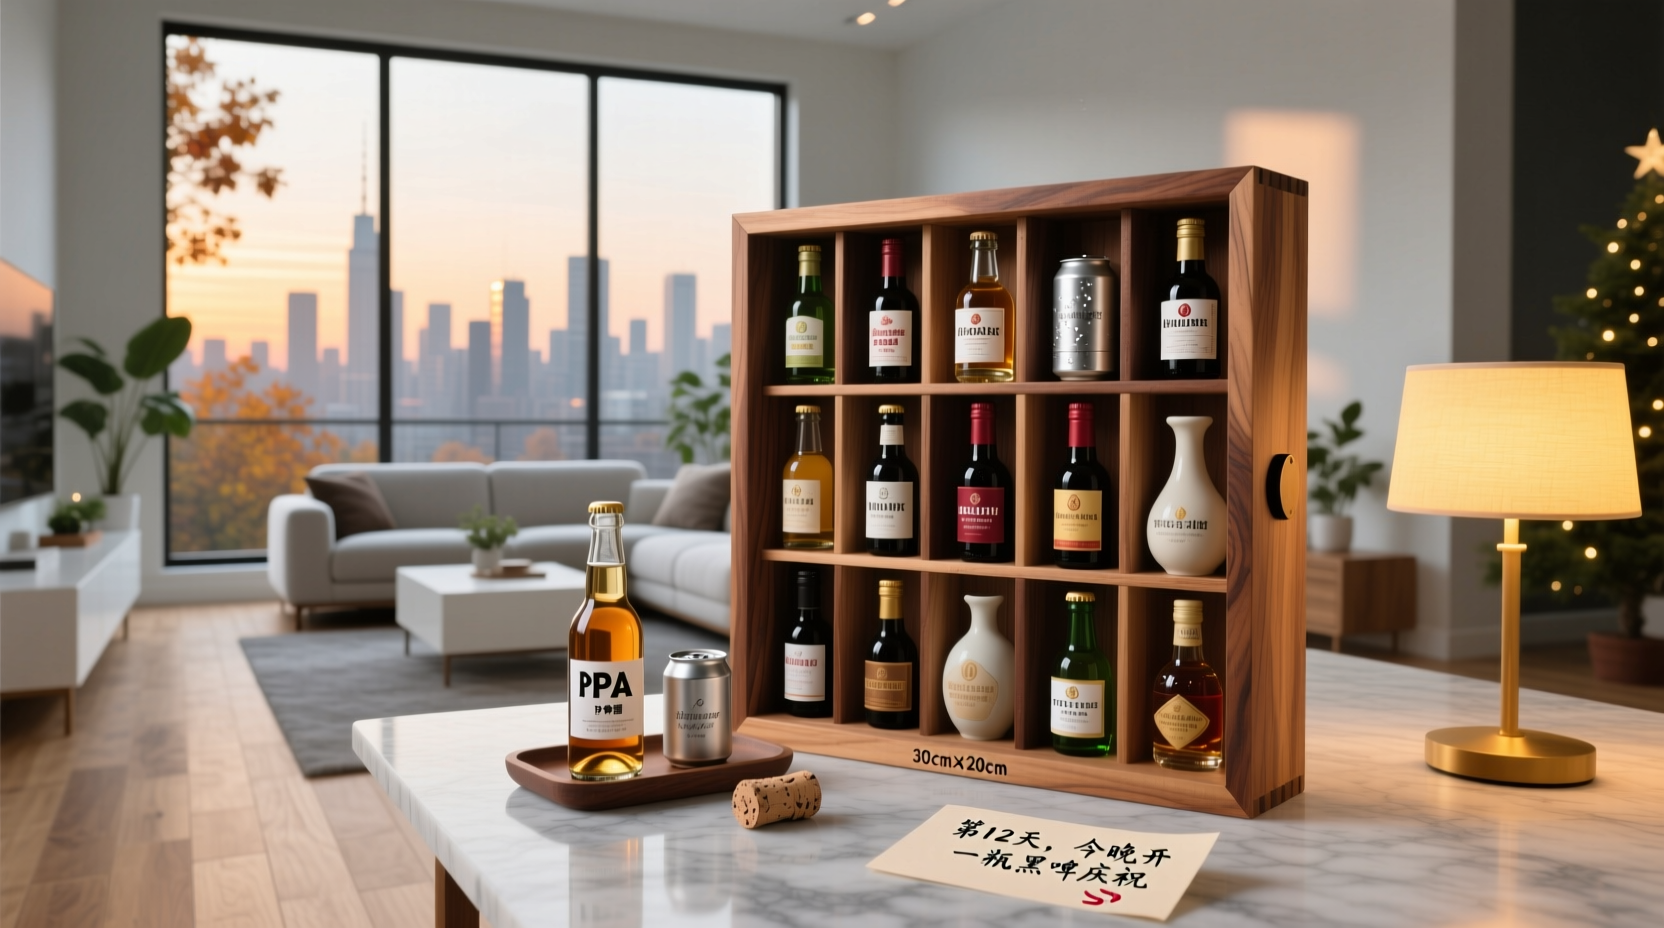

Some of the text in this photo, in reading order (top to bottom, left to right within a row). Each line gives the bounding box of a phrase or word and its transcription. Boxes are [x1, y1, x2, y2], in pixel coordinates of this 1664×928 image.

[579, 671, 633, 698] PPA
[953, 849, 1148, 889] 一瓶黑啤庆祝
